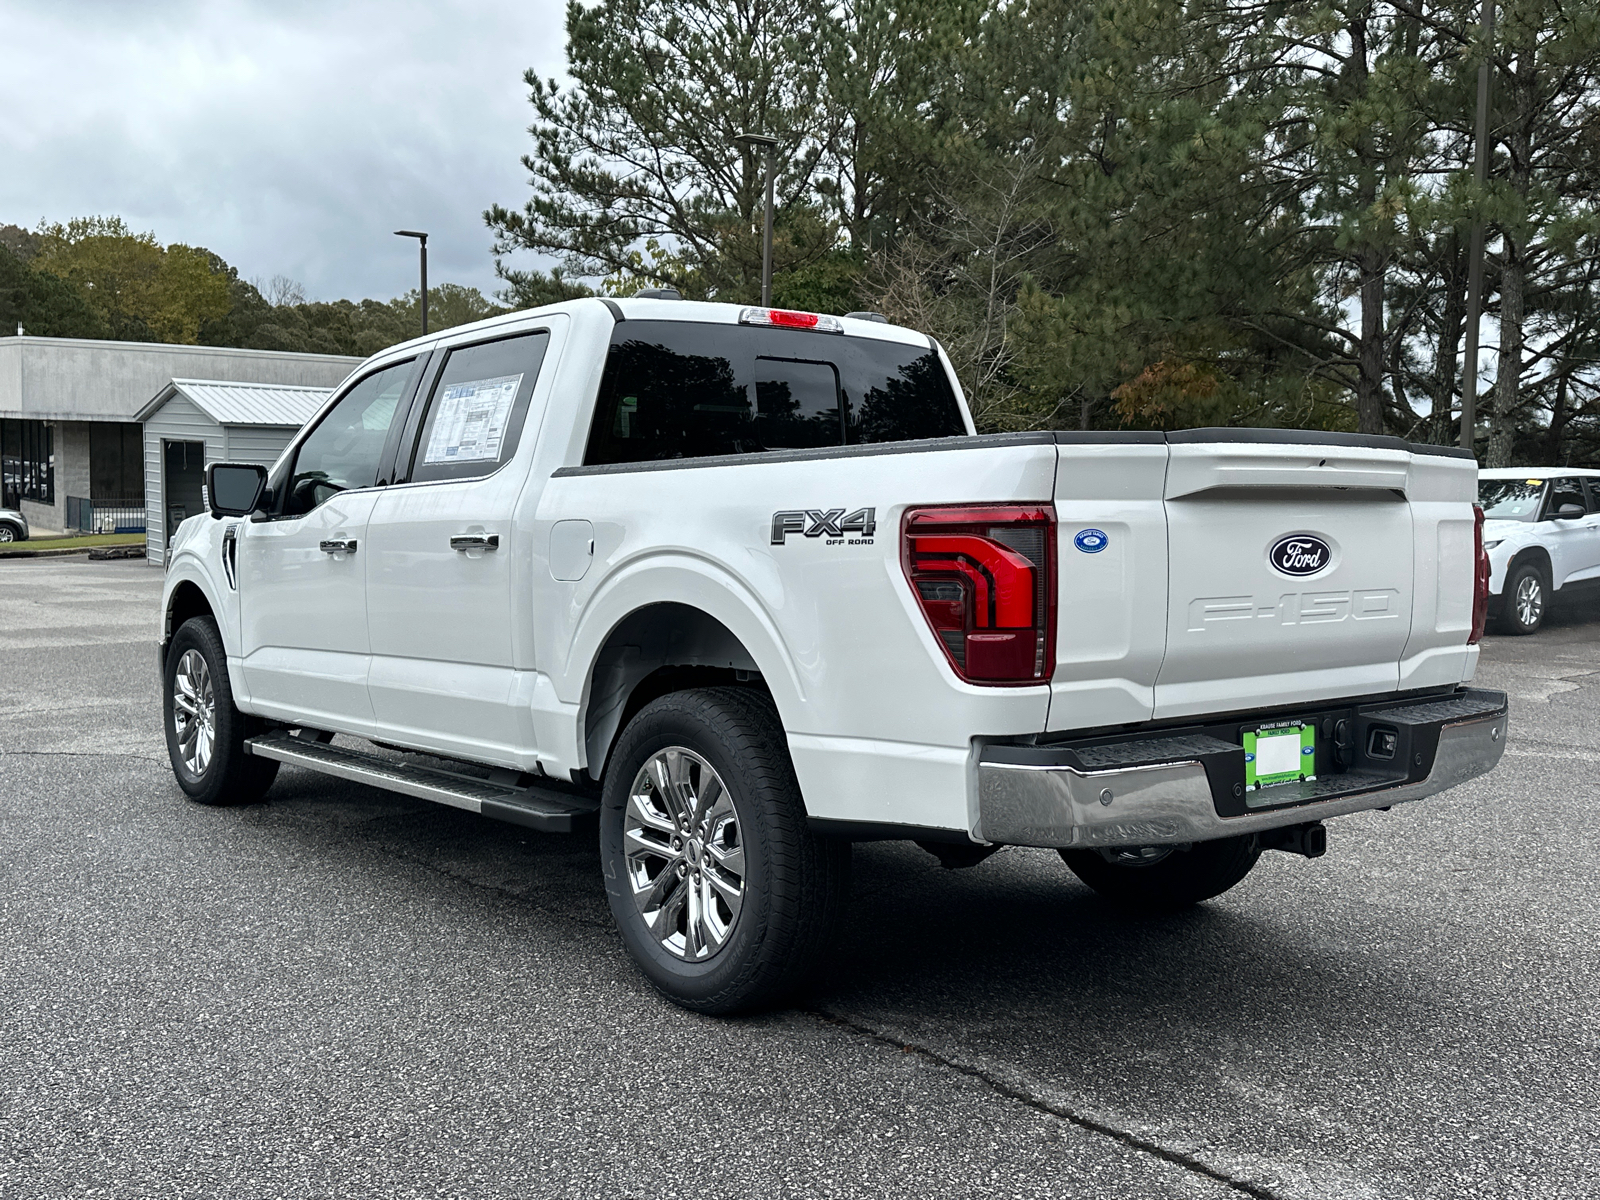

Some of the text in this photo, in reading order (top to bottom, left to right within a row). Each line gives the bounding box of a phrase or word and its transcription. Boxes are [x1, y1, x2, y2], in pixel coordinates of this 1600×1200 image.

[770, 507, 876, 546] FX4
[1283, 541, 1322, 568] Ford
[1187, 588, 1400, 632] F-150
